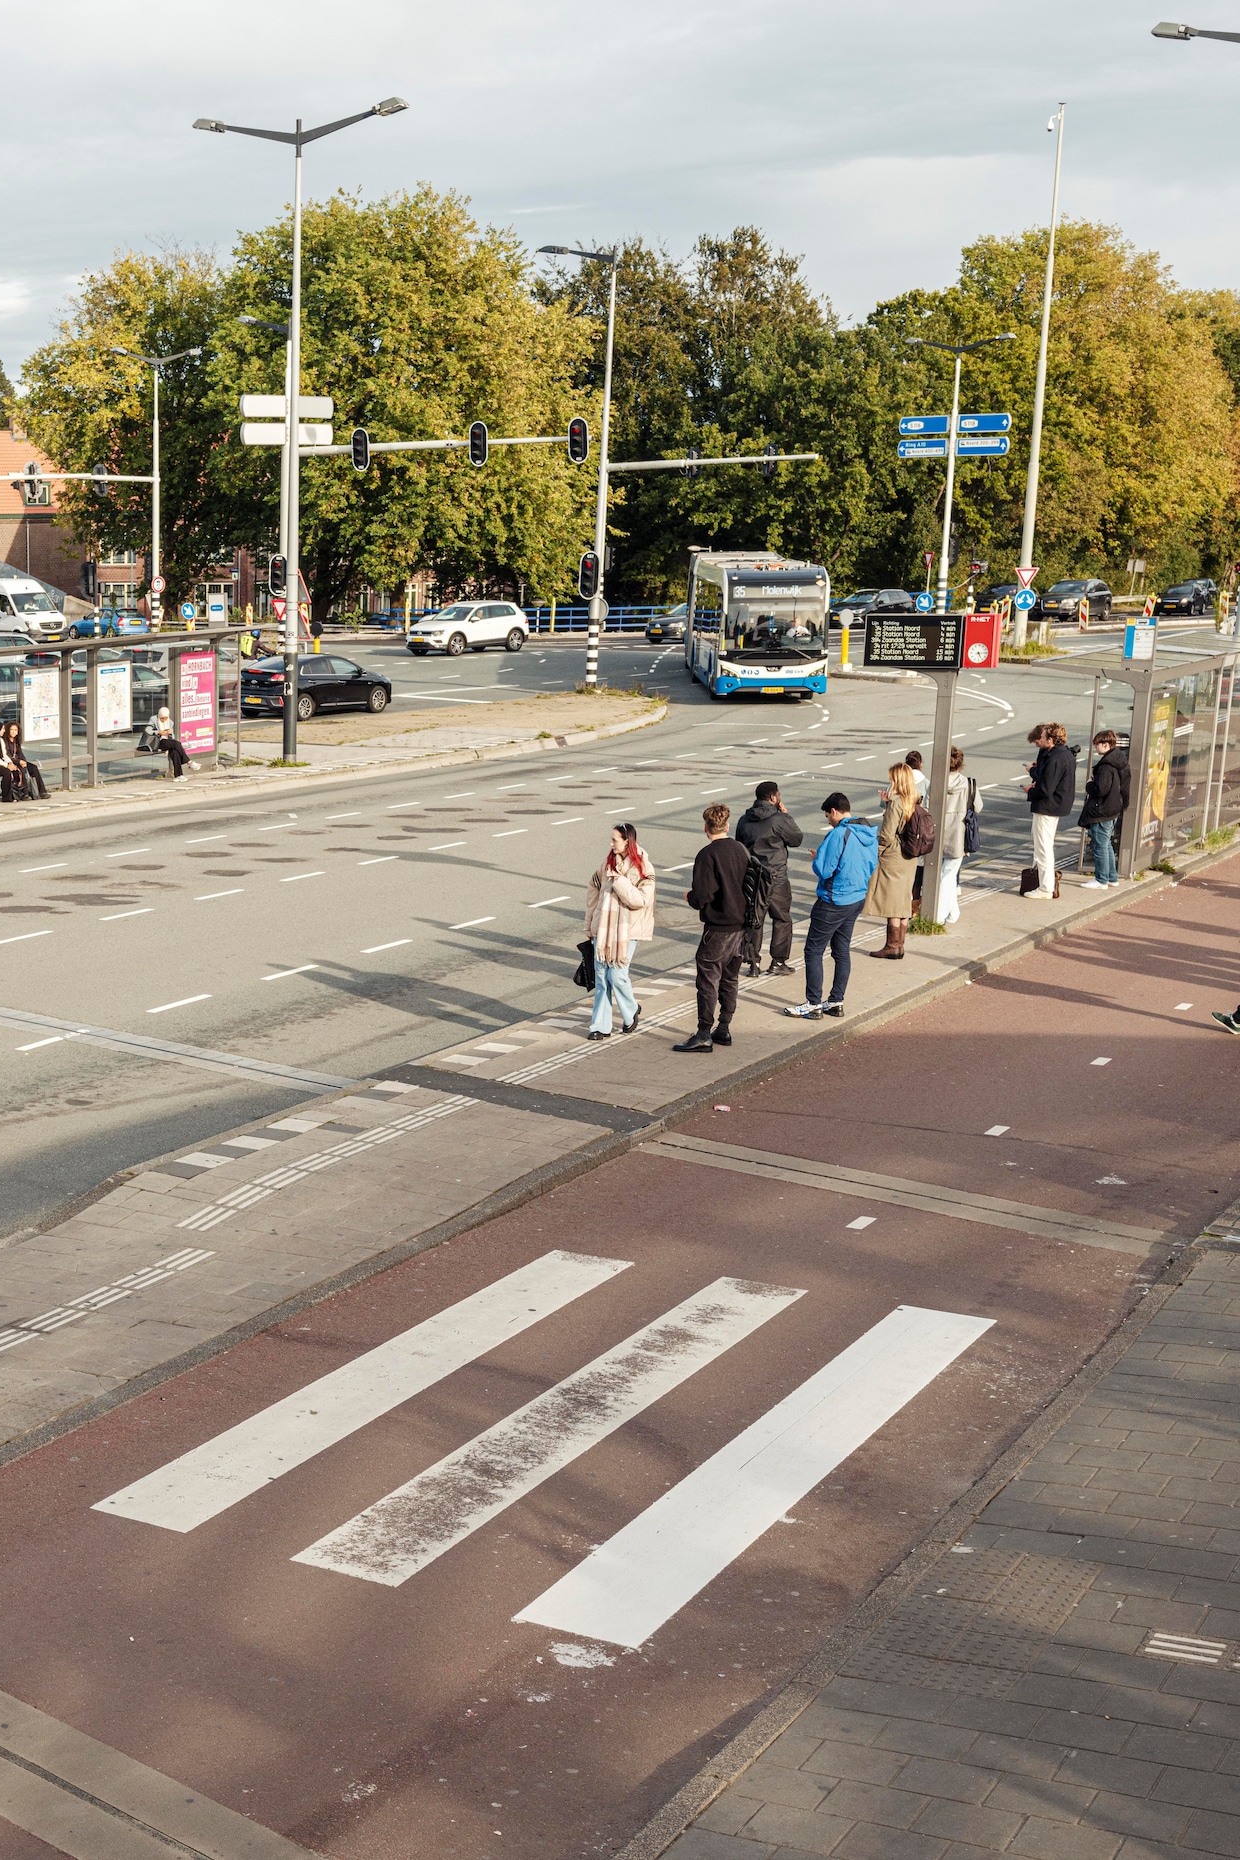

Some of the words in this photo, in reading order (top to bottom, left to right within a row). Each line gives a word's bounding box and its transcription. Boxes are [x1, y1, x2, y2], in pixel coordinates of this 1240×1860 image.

[734, 586, 746, 597] 35
[762, 585, 802, 596] Molenwijk
[188, 661, 212, 673] HORNBACH
